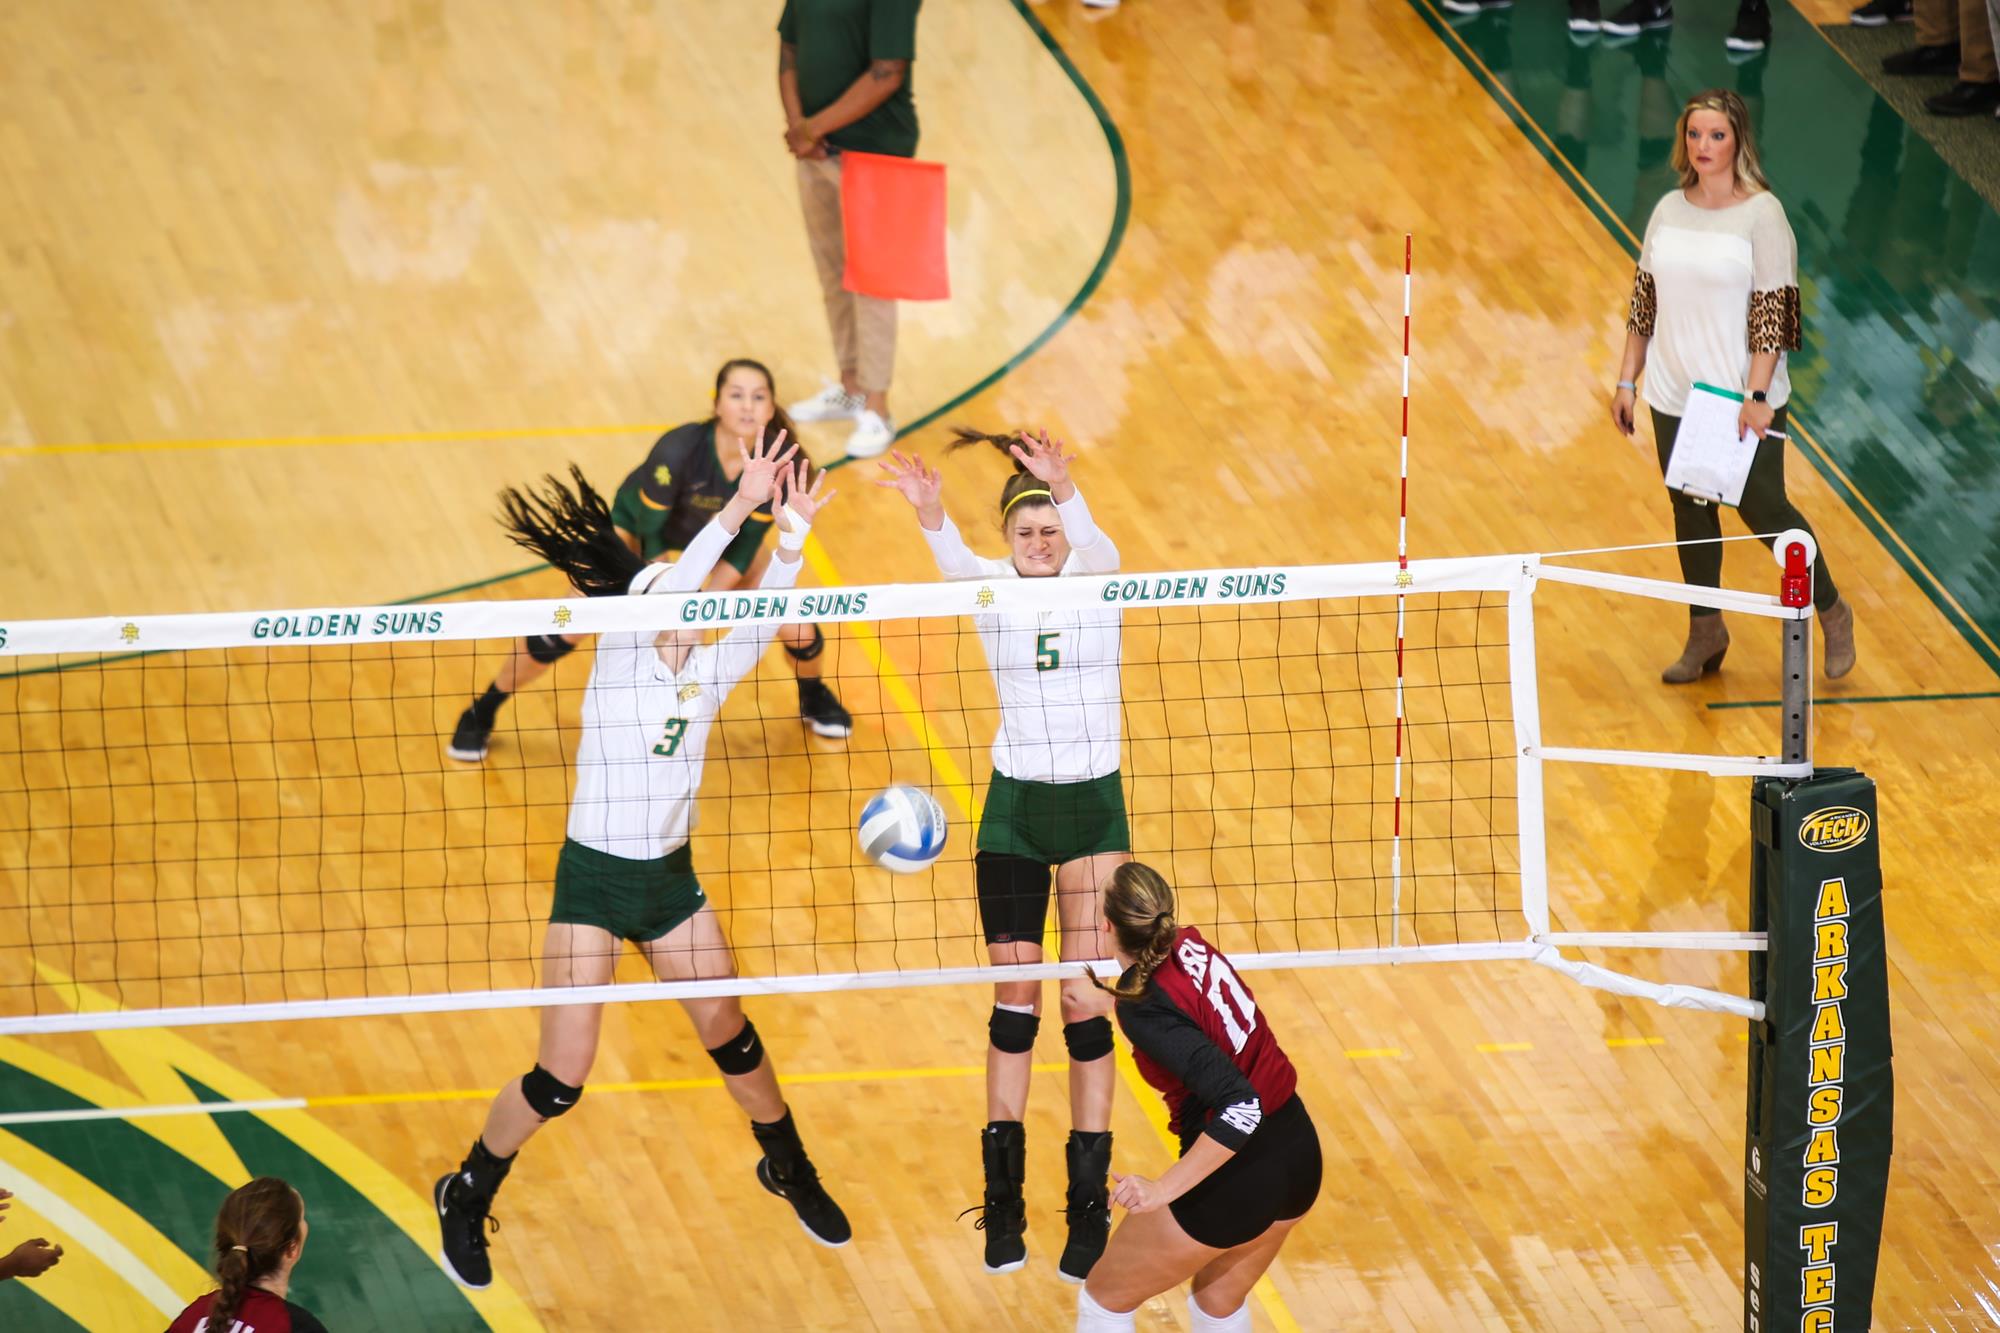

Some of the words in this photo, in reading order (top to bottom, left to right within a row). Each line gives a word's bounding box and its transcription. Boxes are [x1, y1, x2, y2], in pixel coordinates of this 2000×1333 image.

[1100, 577, 1208, 602] GOLDEN
[1217, 573, 1287, 598] SUNS
[680, 596, 788, 622] GOLDEN
[798, 592, 868, 617] SUNS
[252, 614, 361, 639] GOLDEN
[372, 611, 443, 635] SUNS
[1036, 632, 1061, 672] 5
[652, 717, 689, 757] 3
[1811, 816, 1860, 842] TECH
[1803, 877, 1850, 1208] ARKANSAS
